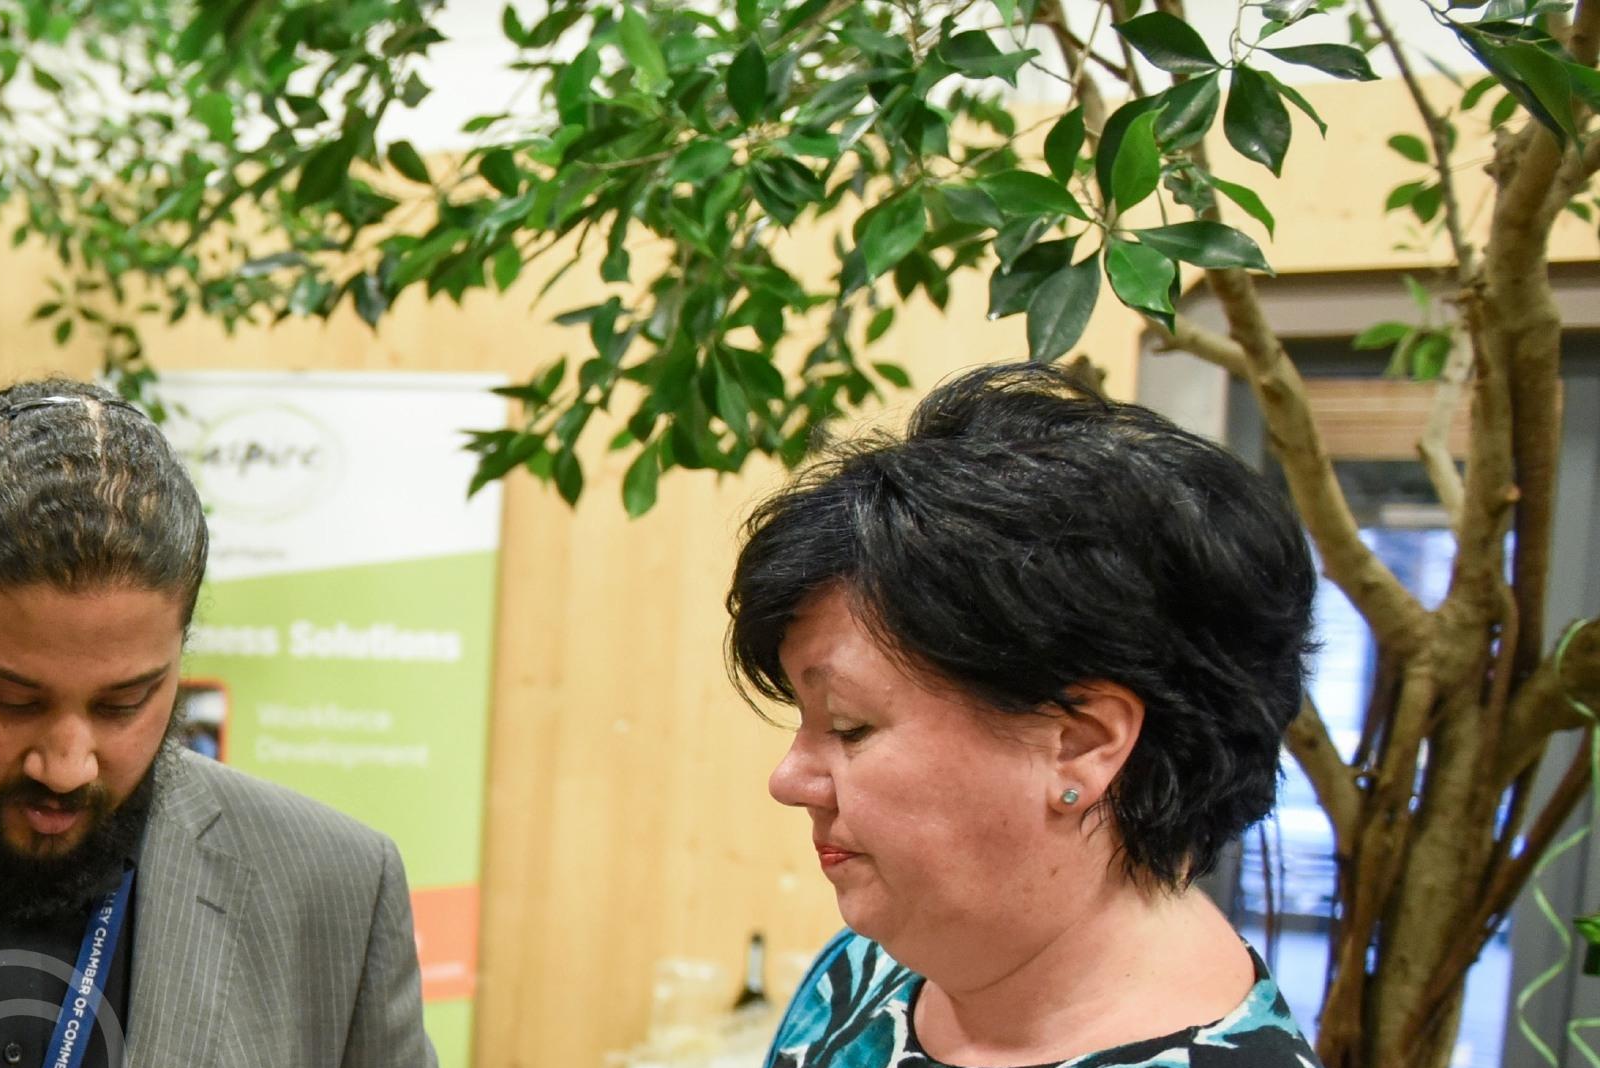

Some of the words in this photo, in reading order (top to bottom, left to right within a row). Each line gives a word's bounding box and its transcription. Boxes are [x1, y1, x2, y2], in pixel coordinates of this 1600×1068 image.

[289, 618, 462, 663] Solutions
[256, 702, 393, 732] Workforce
[255, 735, 429, 771] Development
[78, 927, 107, 996] CHAMBER
[73, 998, 88, 1018] OF
